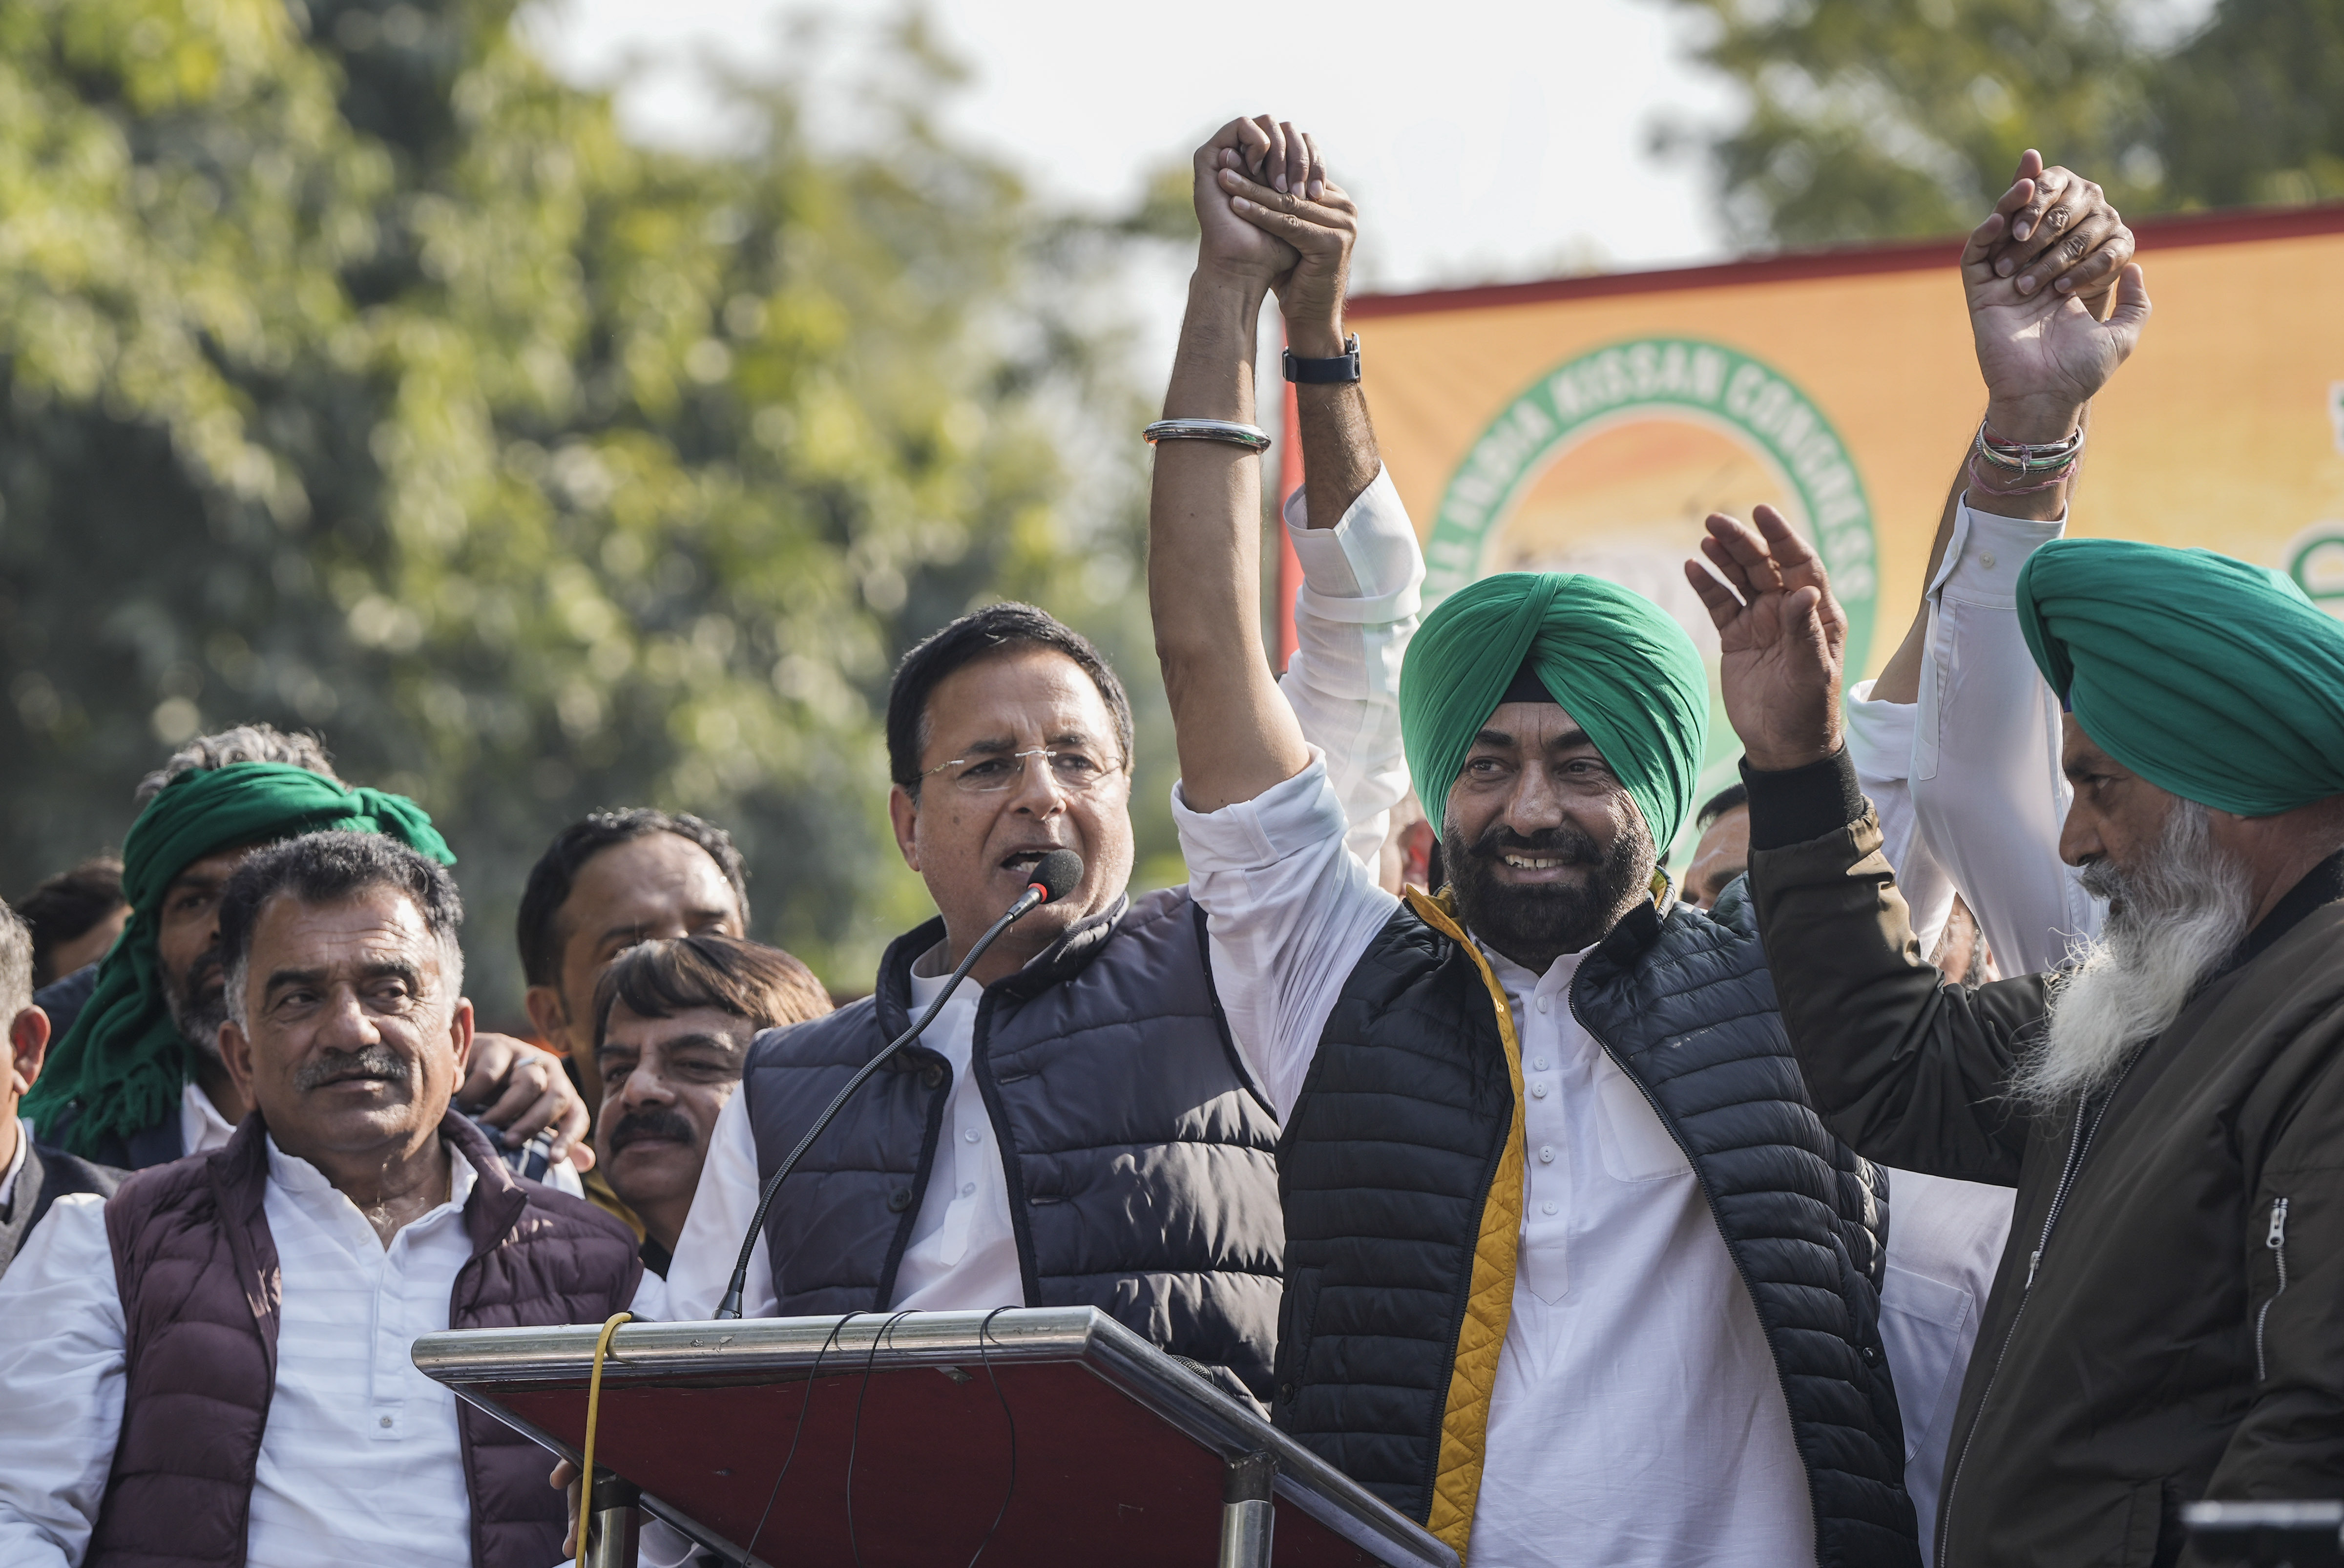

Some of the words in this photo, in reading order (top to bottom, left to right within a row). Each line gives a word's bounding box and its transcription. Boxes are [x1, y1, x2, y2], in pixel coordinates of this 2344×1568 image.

[1441, 399, 1556, 532] INDIA
[1549, 341, 1730, 423] KISSAN
[1725, 363, 1876, 601] CONGRESS
